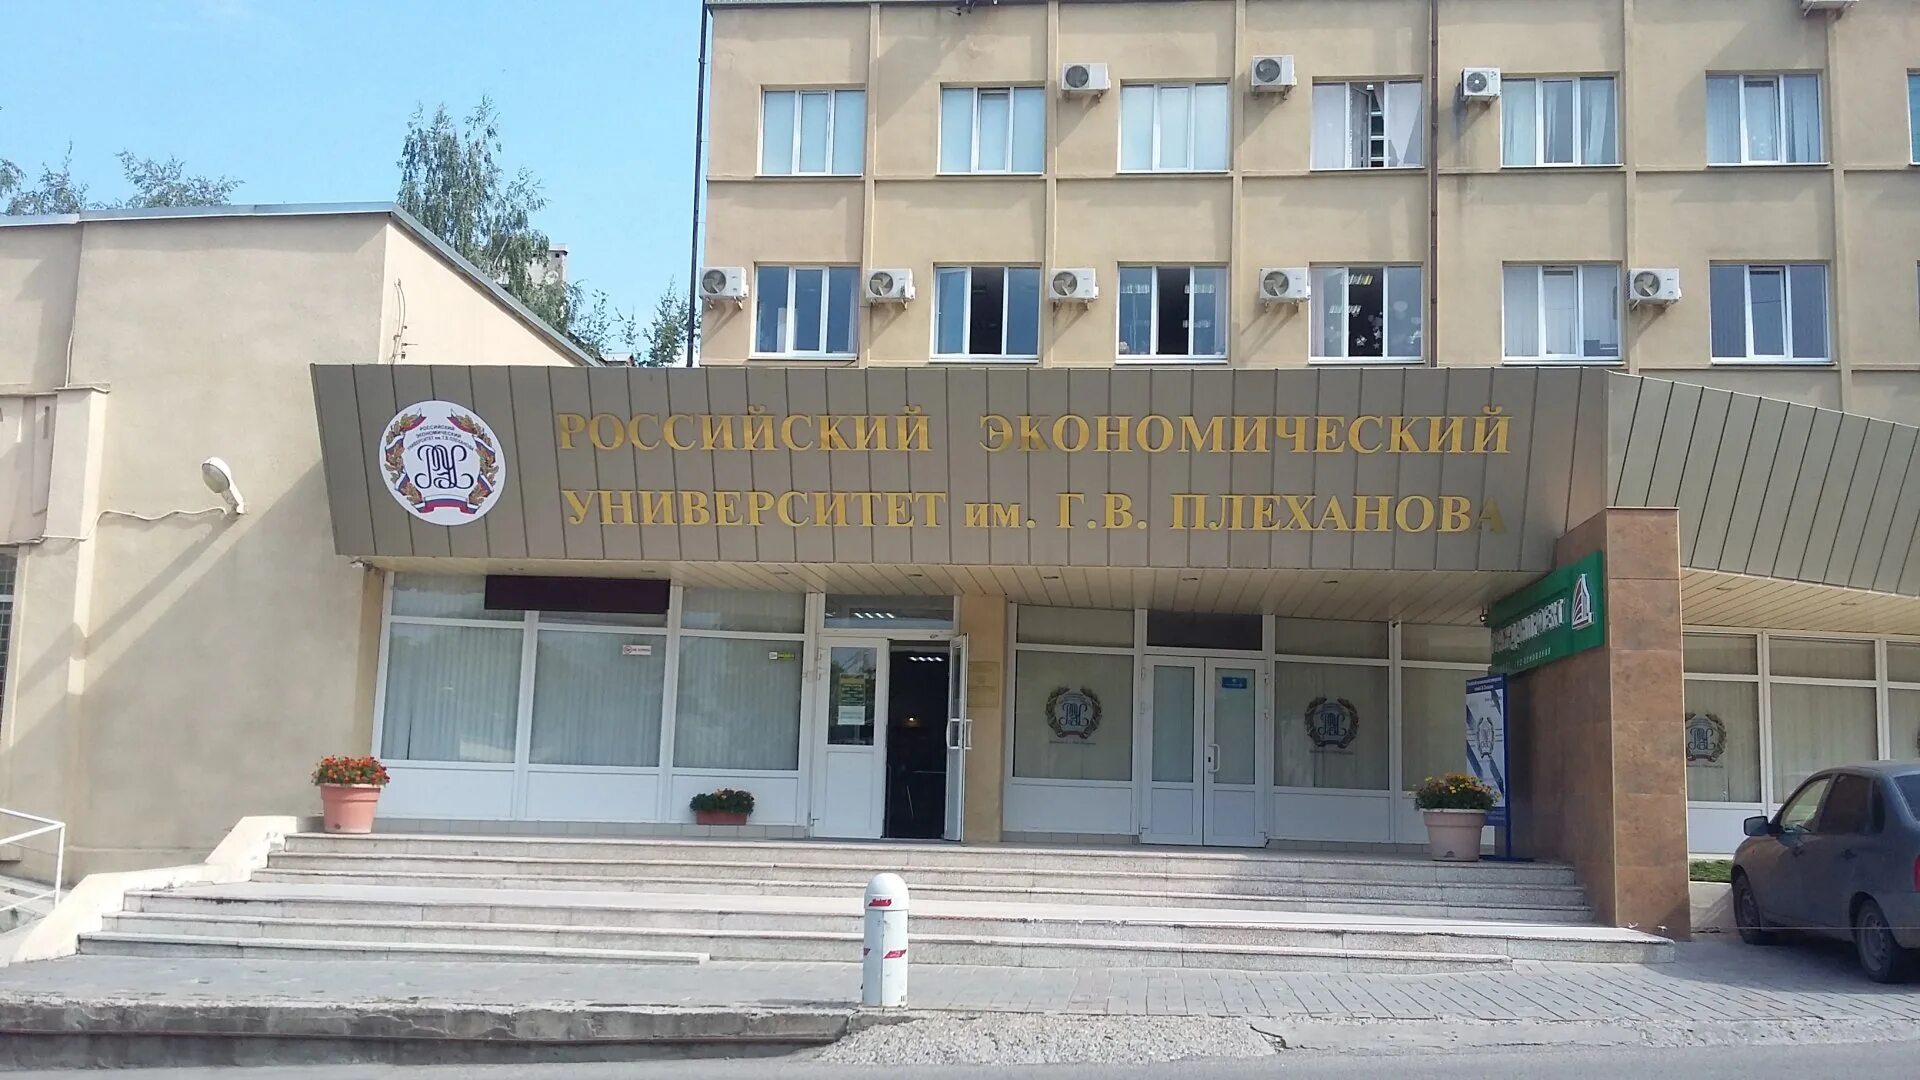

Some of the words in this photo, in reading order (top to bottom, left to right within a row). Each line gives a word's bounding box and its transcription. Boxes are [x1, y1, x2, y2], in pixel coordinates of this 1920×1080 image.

[557, 404, 933, 452] РОССИЙСКИЙ
[978, 406, 1512, 455] ЭКОНОМИЧЕСКИЙ
[560, 488, 947, 529] УНИВЕРСИТЕТ
[963, 501, 1037, 529] им.
[1055, 491, 1148, 530] Г.В.
[1169, 492, 1510, 534] ПЛЕХАНОВА
